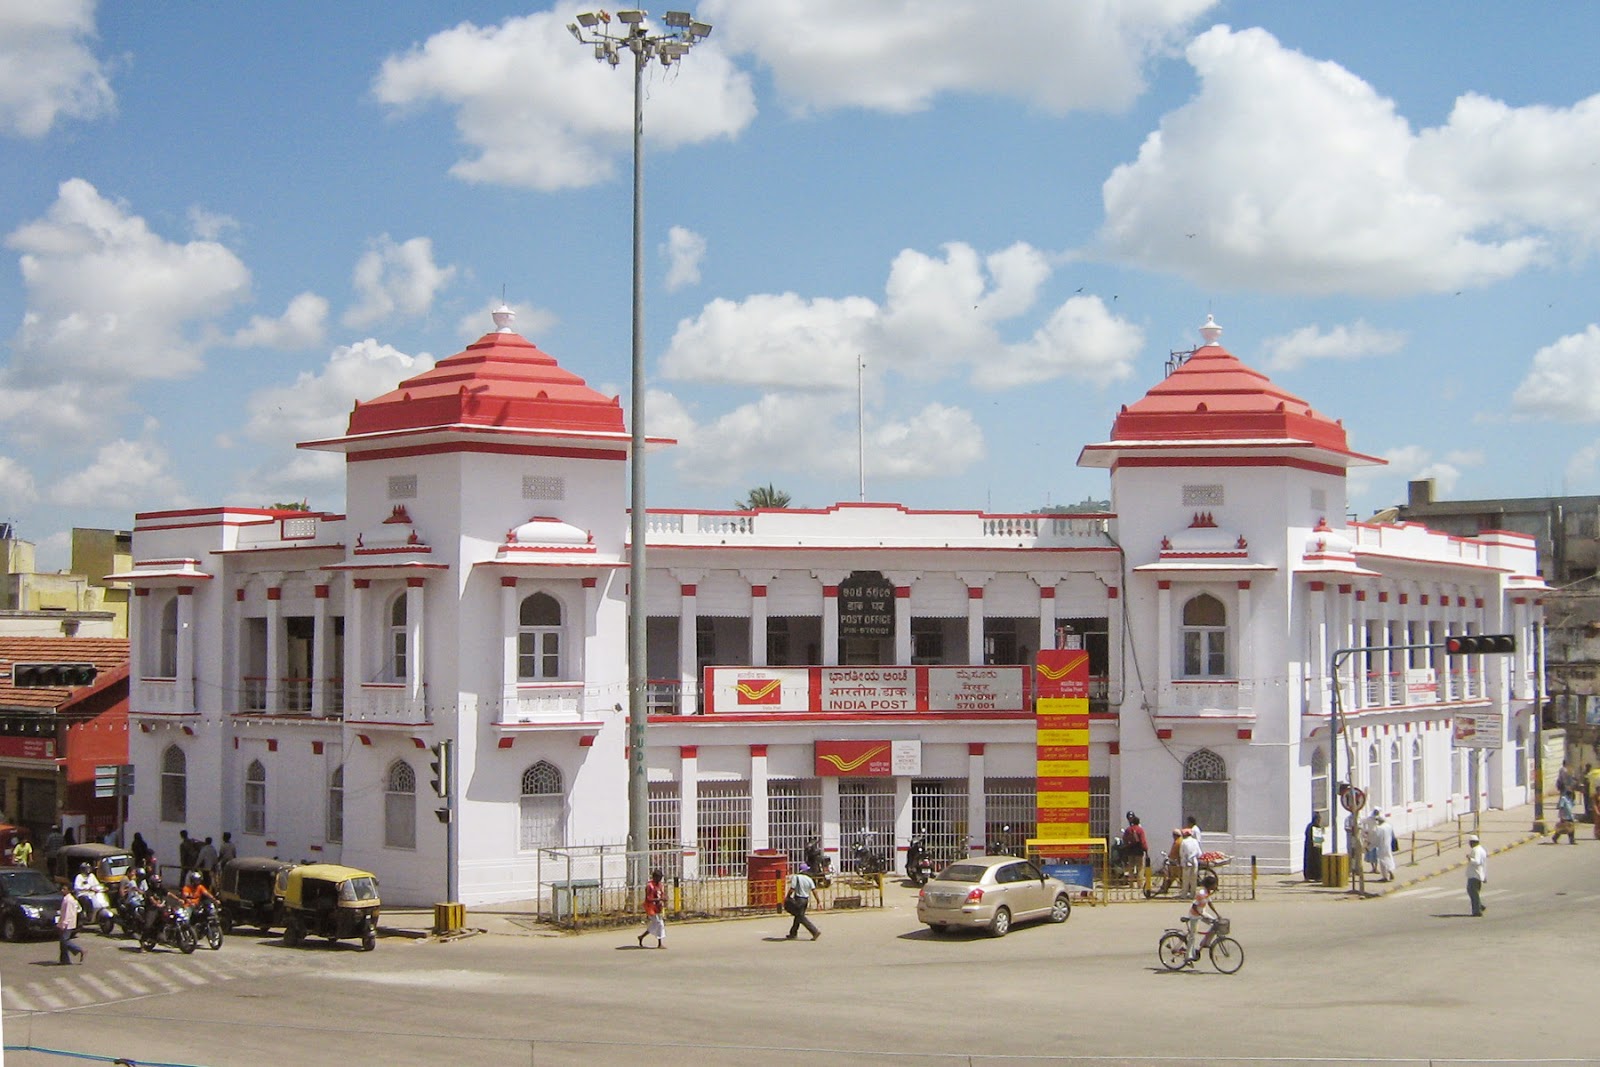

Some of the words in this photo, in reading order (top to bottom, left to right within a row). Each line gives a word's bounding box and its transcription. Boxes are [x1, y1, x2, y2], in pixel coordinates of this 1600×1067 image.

[841, 615, 863, 624] POST
[864, 615, 892, 624] OFFICE
[828, 670, 880, 684] ಭಾರತೀಯ
[882, 669, 908, 681] ಅಂಚೆ
[829, 684, 877, 697] भारतीय
[880, 687, 907, 697] डाक
[829, 700, 867, 710] INDIA
[870, 700, 908, 709] POST
[636, 724, 644, 775] MUDA
